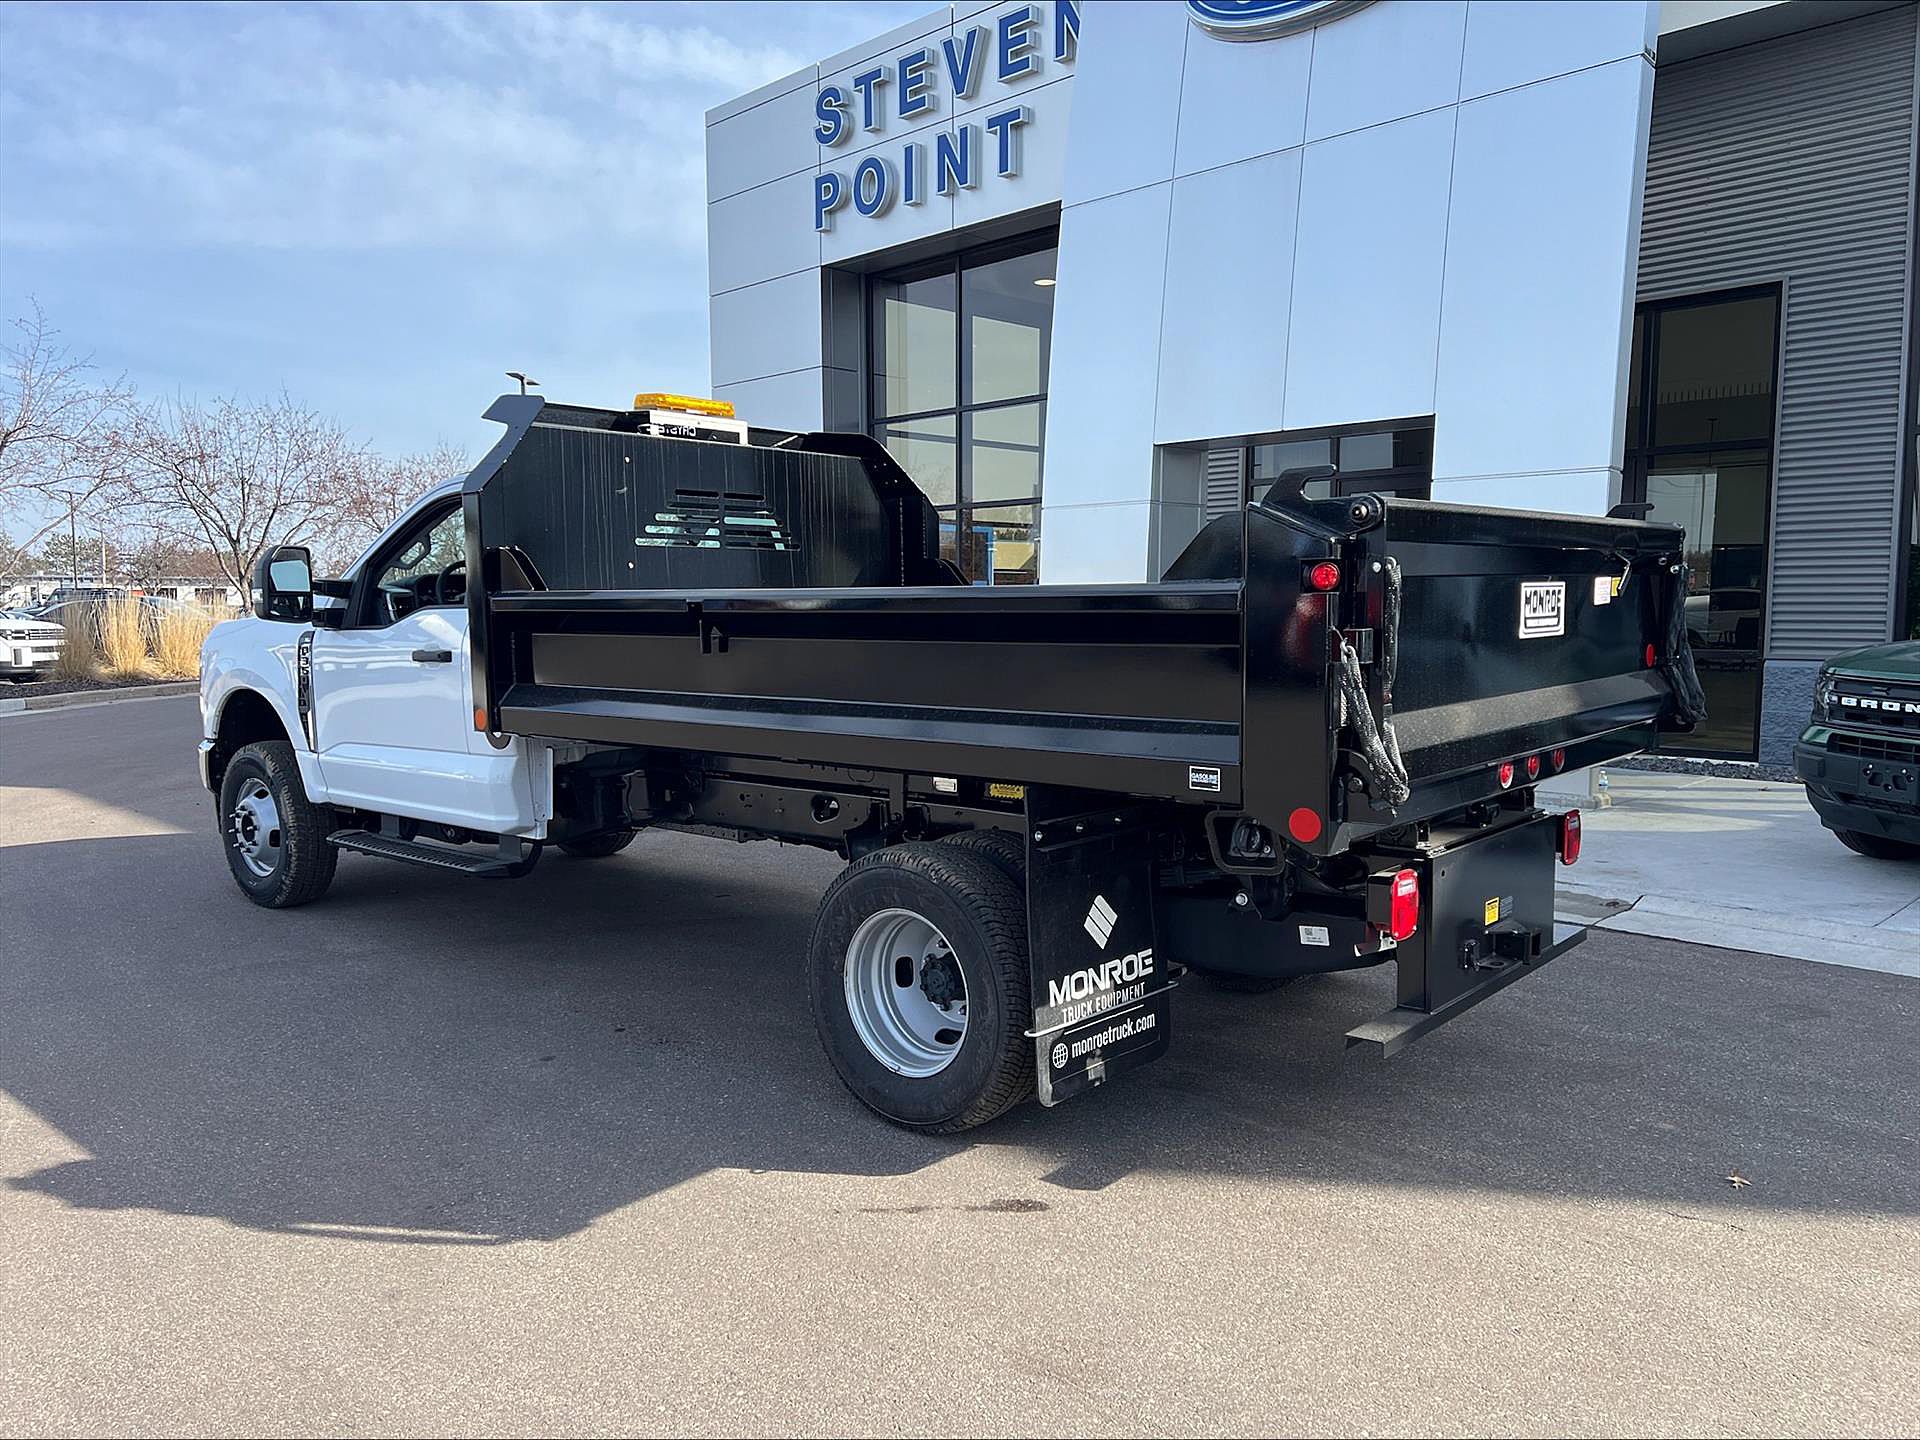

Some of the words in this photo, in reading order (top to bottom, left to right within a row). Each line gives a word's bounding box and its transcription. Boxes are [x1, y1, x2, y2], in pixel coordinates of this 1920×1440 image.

[813, 105, 1030, 233] POINT
[1524, 588, 1562, 615] MONROE
[1048, 948, 1153, 1008] MONROE
[1061, 1003, 1094, 1025] TRUCK
[1095, 981, 1146, 1013] EQUIPMENT
[1071, 1012, 1156, 1059] monroetruck.com
